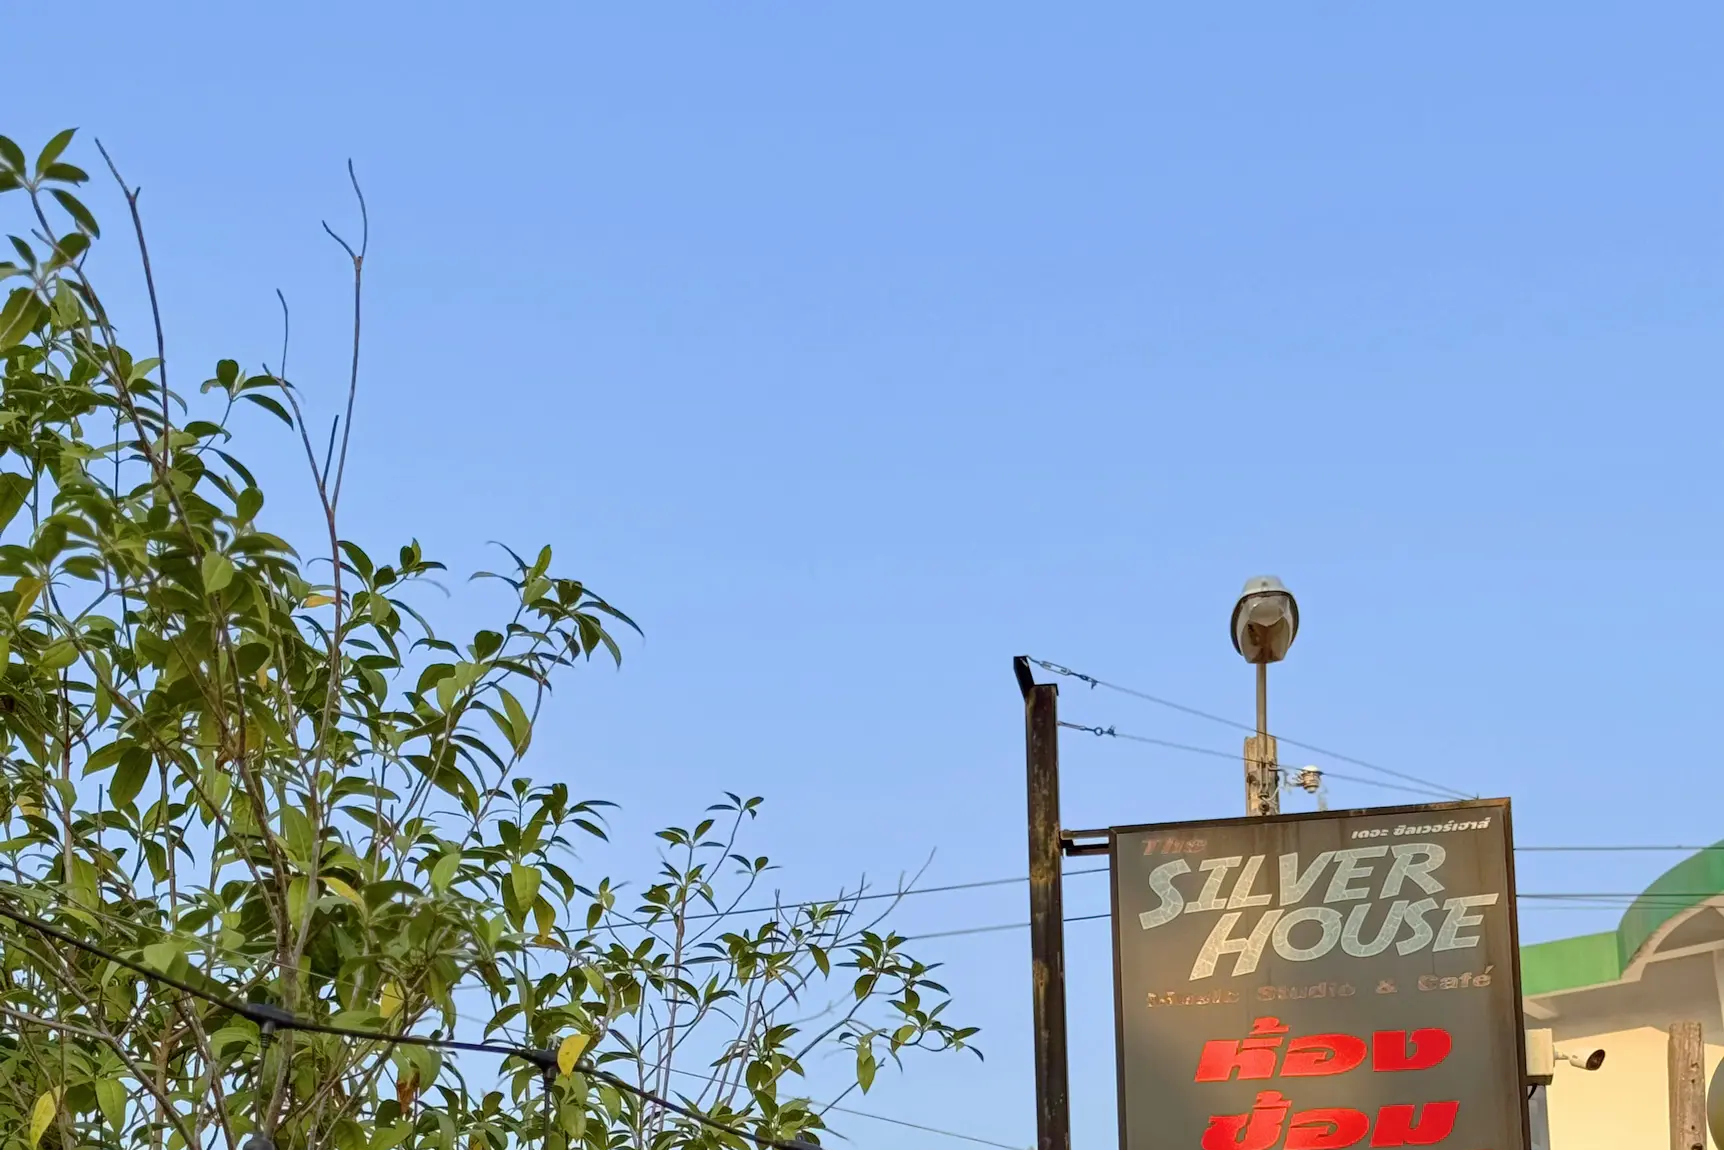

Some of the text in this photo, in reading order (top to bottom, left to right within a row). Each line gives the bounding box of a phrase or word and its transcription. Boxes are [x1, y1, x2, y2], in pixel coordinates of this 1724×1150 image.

[1142, 838, 1207, 856] The
[1138, 843, 1446, 930] SILVER
[1189, 893, 1499, 981] HOUSE
[1257, 980, 1356, 1001] Studio
[1417, 964, 1494, 991] Café
[1194, 1016, 1453, 1082] ห้อง
